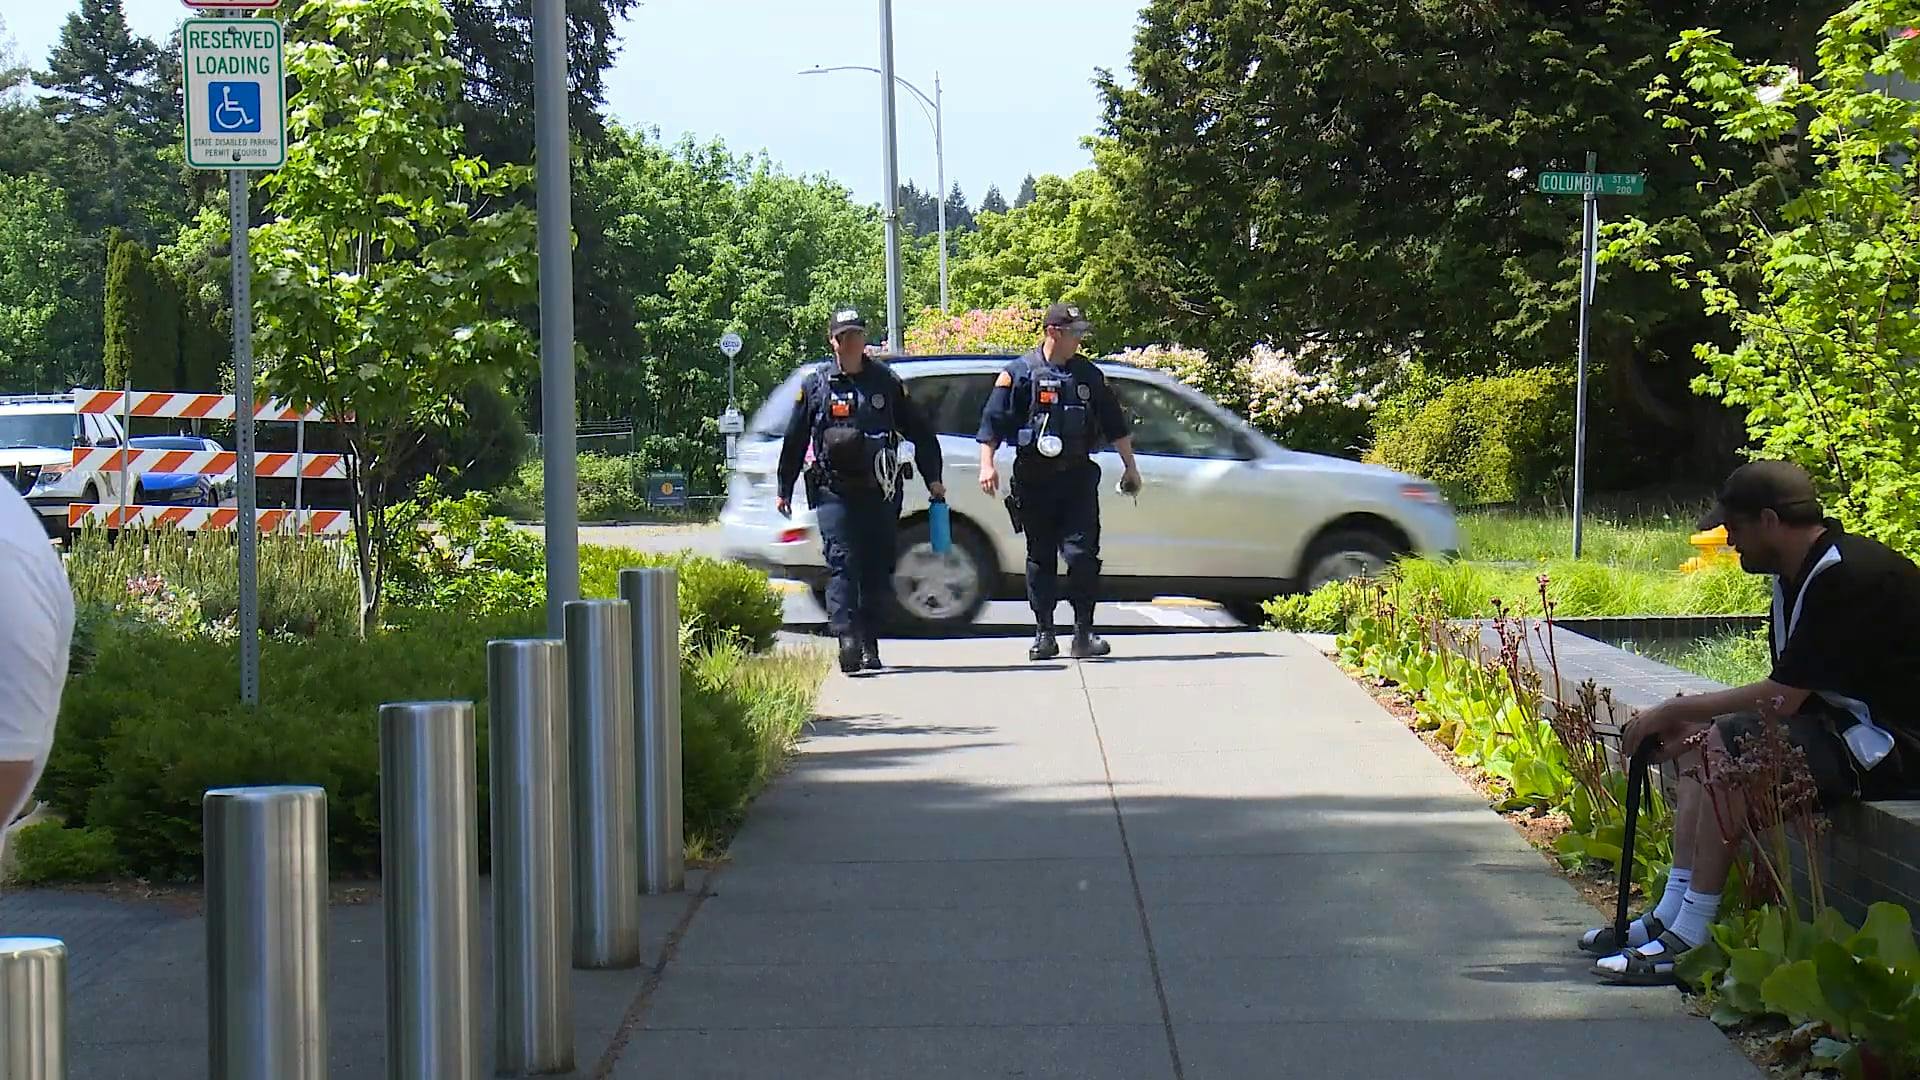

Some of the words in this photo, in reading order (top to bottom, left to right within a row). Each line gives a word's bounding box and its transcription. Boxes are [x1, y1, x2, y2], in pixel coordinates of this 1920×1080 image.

[190, 30, 275, 49] RESERVED
[196, 56, 270, 74] LOADING
[193, 138, 212, 147] STATE
[215, 138, 248, 147] DISABLED
[250, 138, 278, 147] PARKING
[204, 148, 229, 157] PERMIT
[1542, 175, 1604, 192] COLUMBIA
[1626, 176, 1637, 184] SW
[1616, 186, 1632, 194] 200
